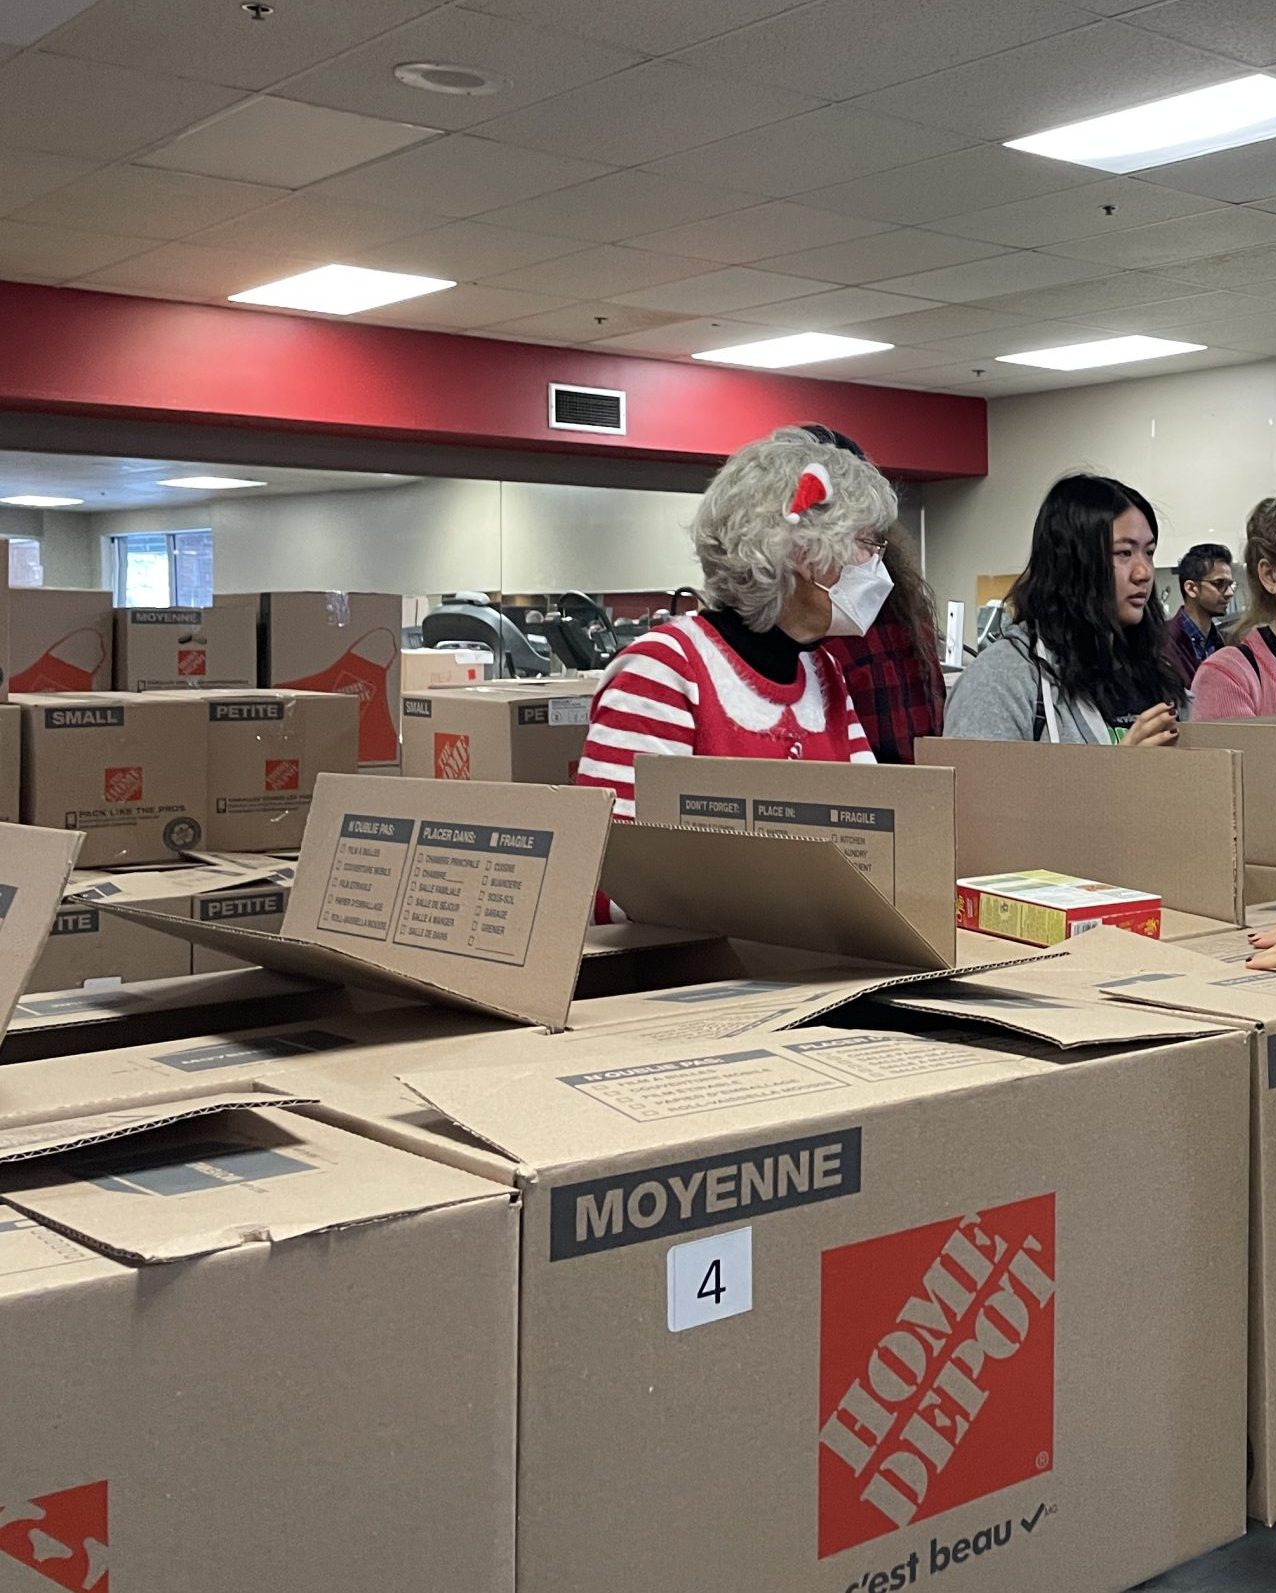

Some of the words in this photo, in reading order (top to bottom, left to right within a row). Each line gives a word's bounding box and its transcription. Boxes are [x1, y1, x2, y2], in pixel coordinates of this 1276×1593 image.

[215, 701, 280, 719] PETITE
[406, 700, 430, 715] SMALL
[52, 709, 119, 726] SMALL
[685, 799, 707, 812] DON'T
[758, 804, 784, 817] PLACE
[840, 810, 876, 825] FRAGILE
[423, 827, 453, 842] PLACER
[500, 833, 535, 849] FRAGILE
[208, 896, 278, 917] PETITE
[58, 914, 92, 931] ITE
[575, 1142, 844, 1241] MOYENNE
[696, 1258, 727, 1305] 4
[818, 1213, 1008, 1477] HOME
[860, 1234, 1056, 1527] DEPOT
[929, 1519, 1012, 1575] beau
